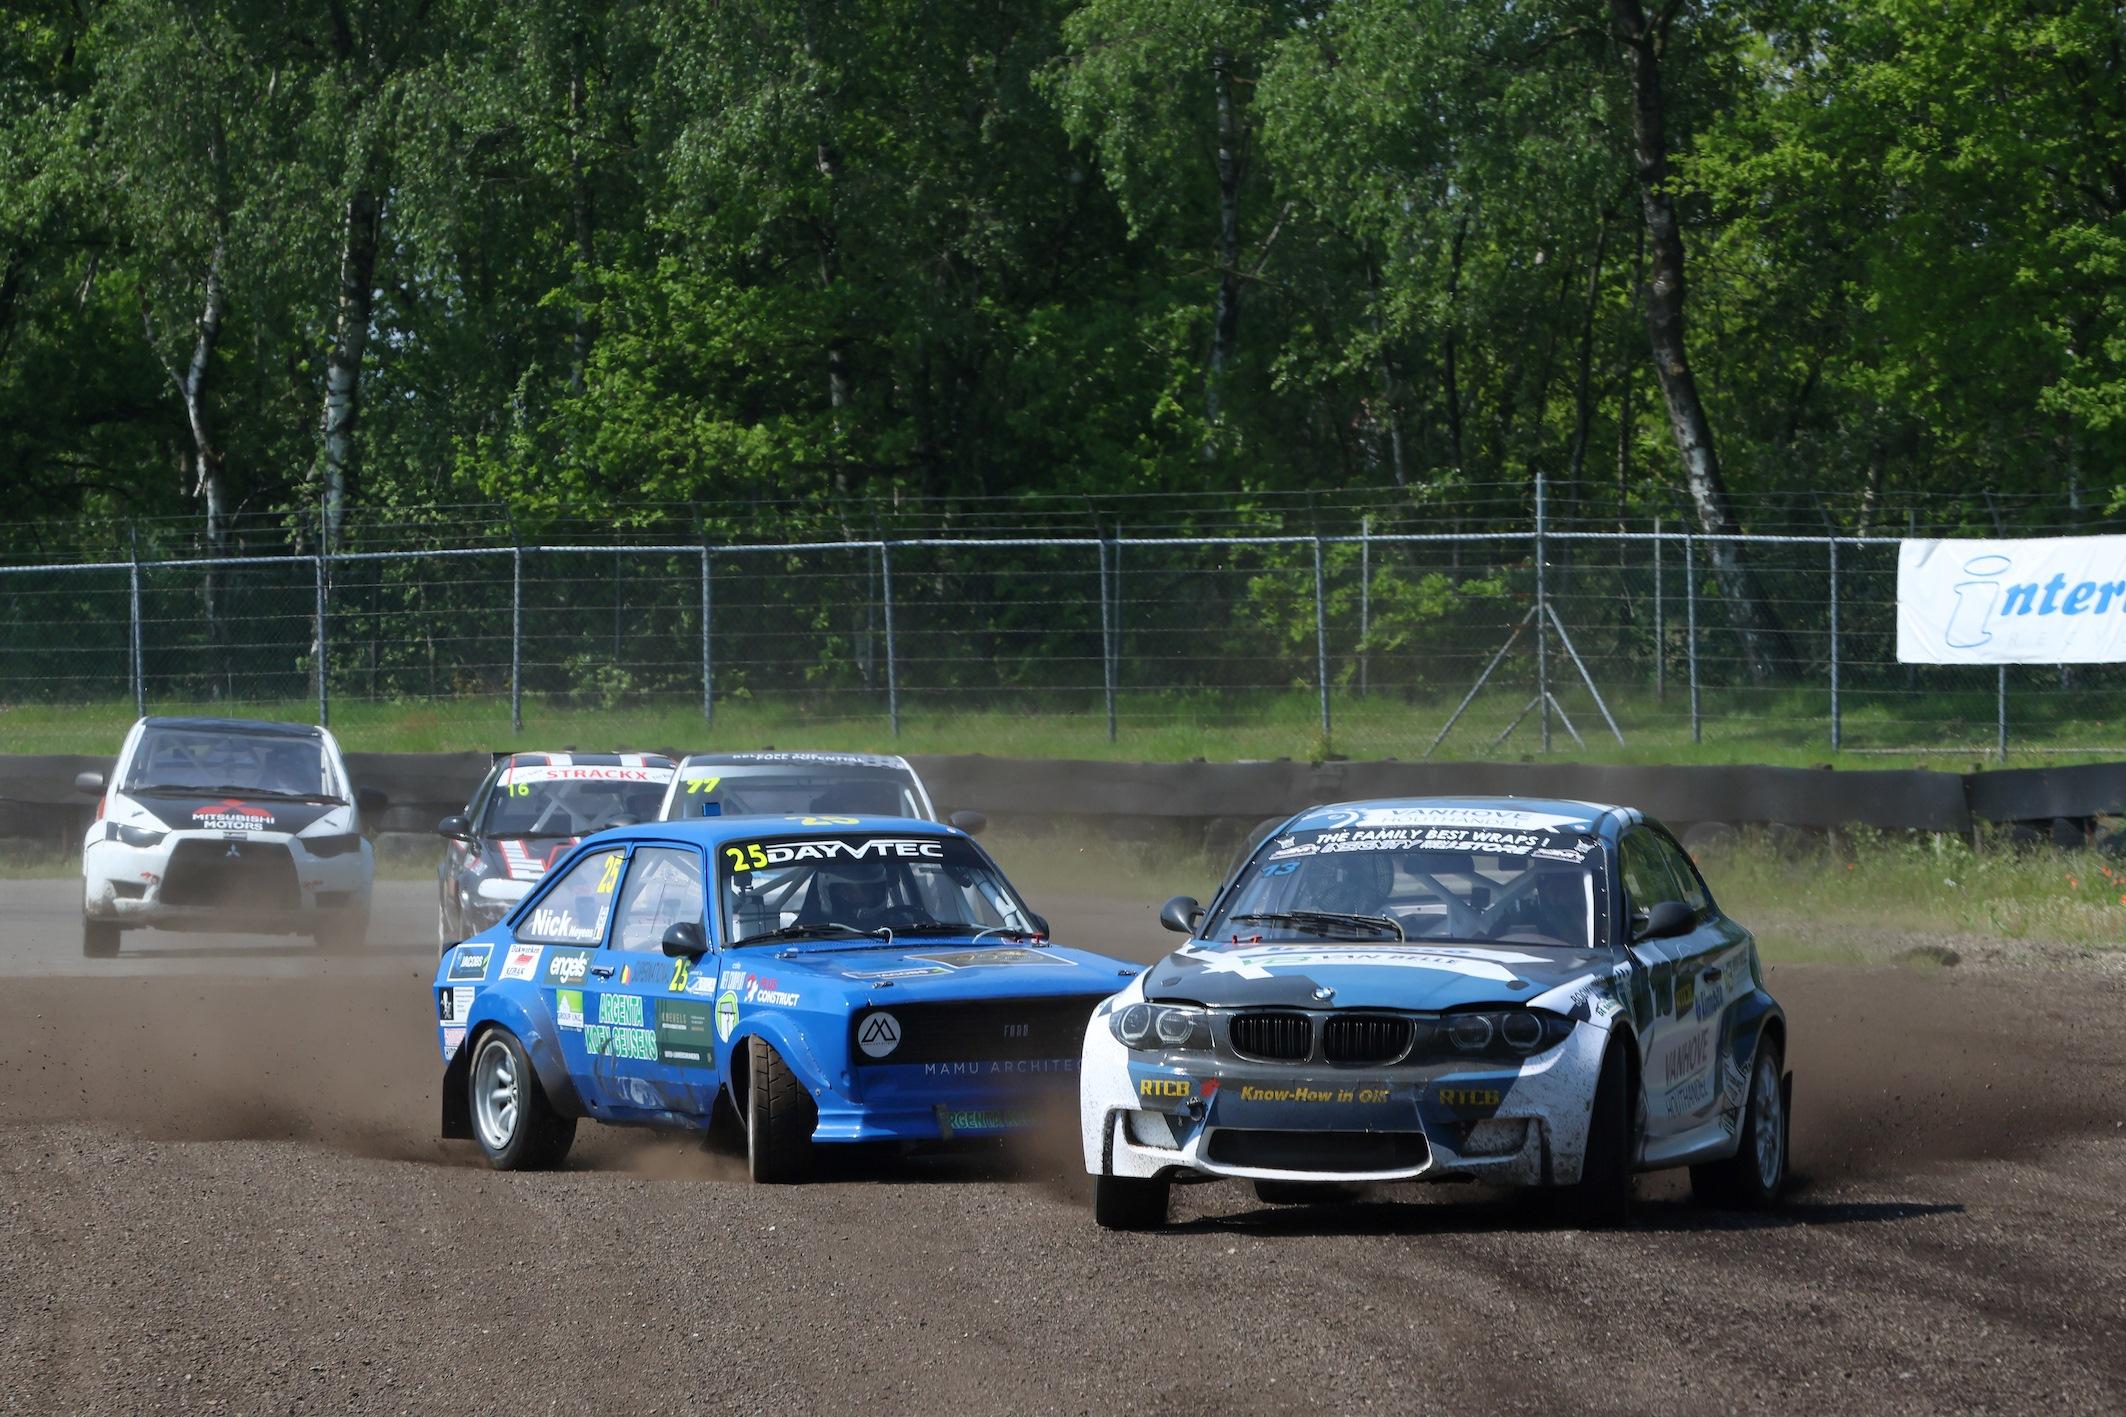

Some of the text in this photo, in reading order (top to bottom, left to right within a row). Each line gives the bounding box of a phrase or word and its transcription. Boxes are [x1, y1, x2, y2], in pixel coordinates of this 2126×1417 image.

[1945, 555, 2126, 648] inter
[547, 769, 647, 780] STRACKX
[508, 783, 530, 798] 16
[687, 777, 720, 794] 77
[192, 813, 275, 824] MITSUBISHI
[1392, 809, 1532, 819] VANHOVE
[203, 820, 263, 831] MOTORS
[1316, 829, 1551, 848] THE FAMILY BEST WRAPS !
[726, 843, 768, 873] 25
[597, 855, 624, 894] 25
[1262, 860, 1302, 878] 13
[531, 908, 572, 937] Nick
[460, 955, 484, 968] JACOBS
[550, 951, 588, 984] engels
[668, 957, 691, 992] 25
[757, 989, 800, 1007] CONSTRUCT
[599, 993, 644, 1027] ARGENTA
[1004, 1024, 1030, 1038] FORD
[584, 1024, 658, 1061] KOEN GEUSENS
[1665, 1028, 1709, 1087] VANHOVE
[925, 1062, 980, 1076] MAMU
[1140, 1079, 1191, 1097] RTCB
[1240, 1086, 1333, 1102] Know-How
[1337, 1089, 1354, 1103] in
[1439, 1087, 1499, 1105] RTCB
